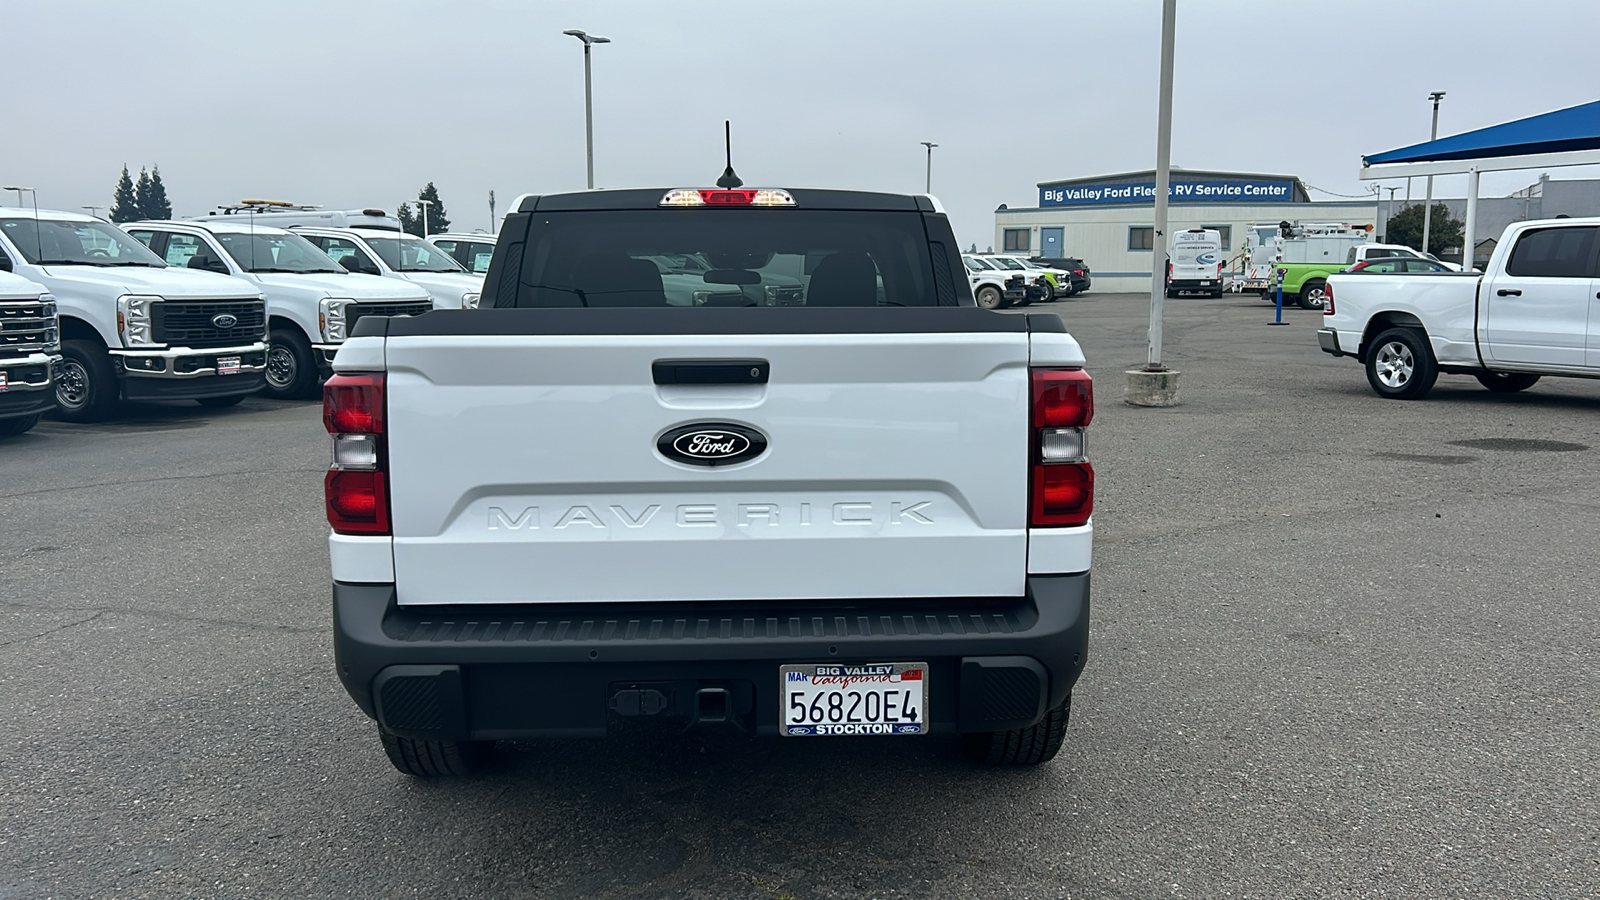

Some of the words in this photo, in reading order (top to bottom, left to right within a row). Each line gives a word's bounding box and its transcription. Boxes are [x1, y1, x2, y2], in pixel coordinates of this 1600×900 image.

[1044, 190, 1063, 202] Big
[1066, 188, 1102, 200] Valley
[1104, 187, 1131, 198] Ford
[1133, 186, 1157, 197] Flee
[1175, 185, 1193, 195] RV
[1195, 184, 1242, 195] Service
[1244, 185, 1287, 195] Center
[688, 435, 735, 454] Ford
[488, 501, 934, 530] MAVERICK
[788, 672, 808, 682] MAR
[816, 667, 840, 676] BIG
[844, 666, 893, 675] VALLEY
[811, 674, 901, 689] California
[790, 690, 918, 723] 56820E4
[815, 724, 893, 735] STOCKTON
